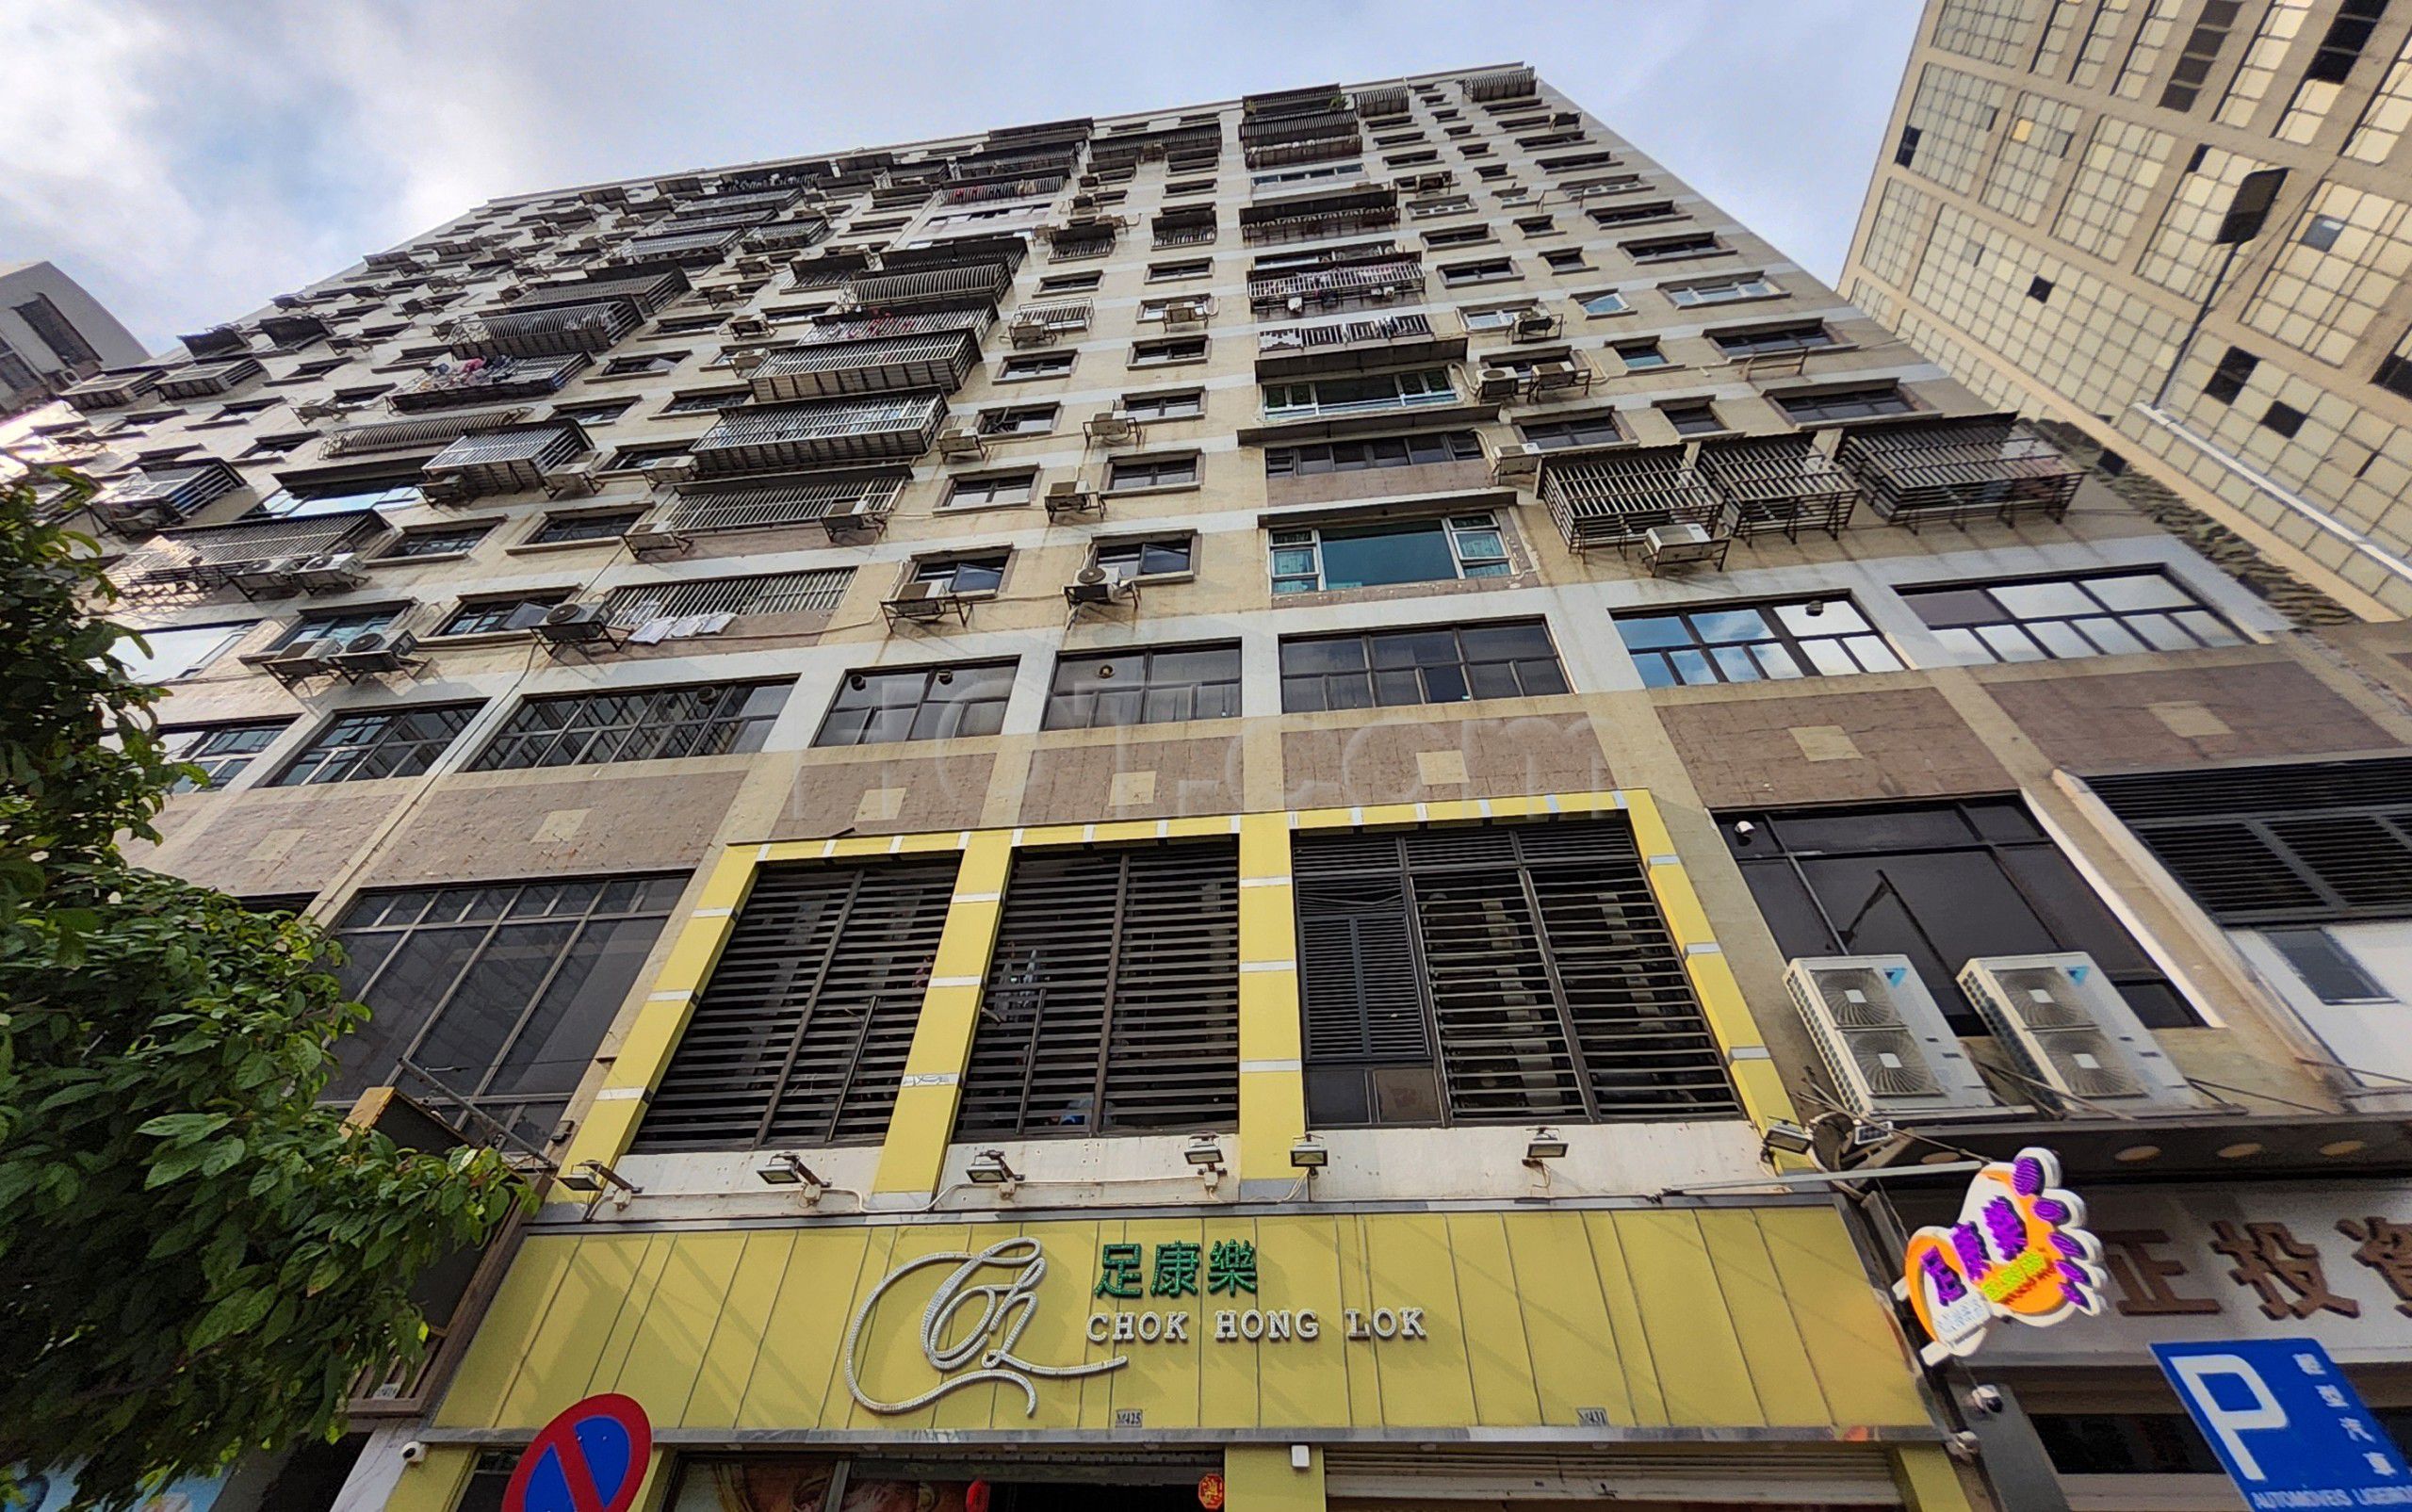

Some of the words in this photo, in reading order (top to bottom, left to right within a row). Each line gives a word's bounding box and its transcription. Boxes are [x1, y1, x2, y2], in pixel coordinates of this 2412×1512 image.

[1094, 1239, 1258, 1298] 足康樂
[1086, 1310, 1188, 1342] CHOK
[1214, 1309, 1319, 1341] HONG
[1346, 1307, 1427, 1341] LOK
[2168, 1354, 2290, 1481] P
